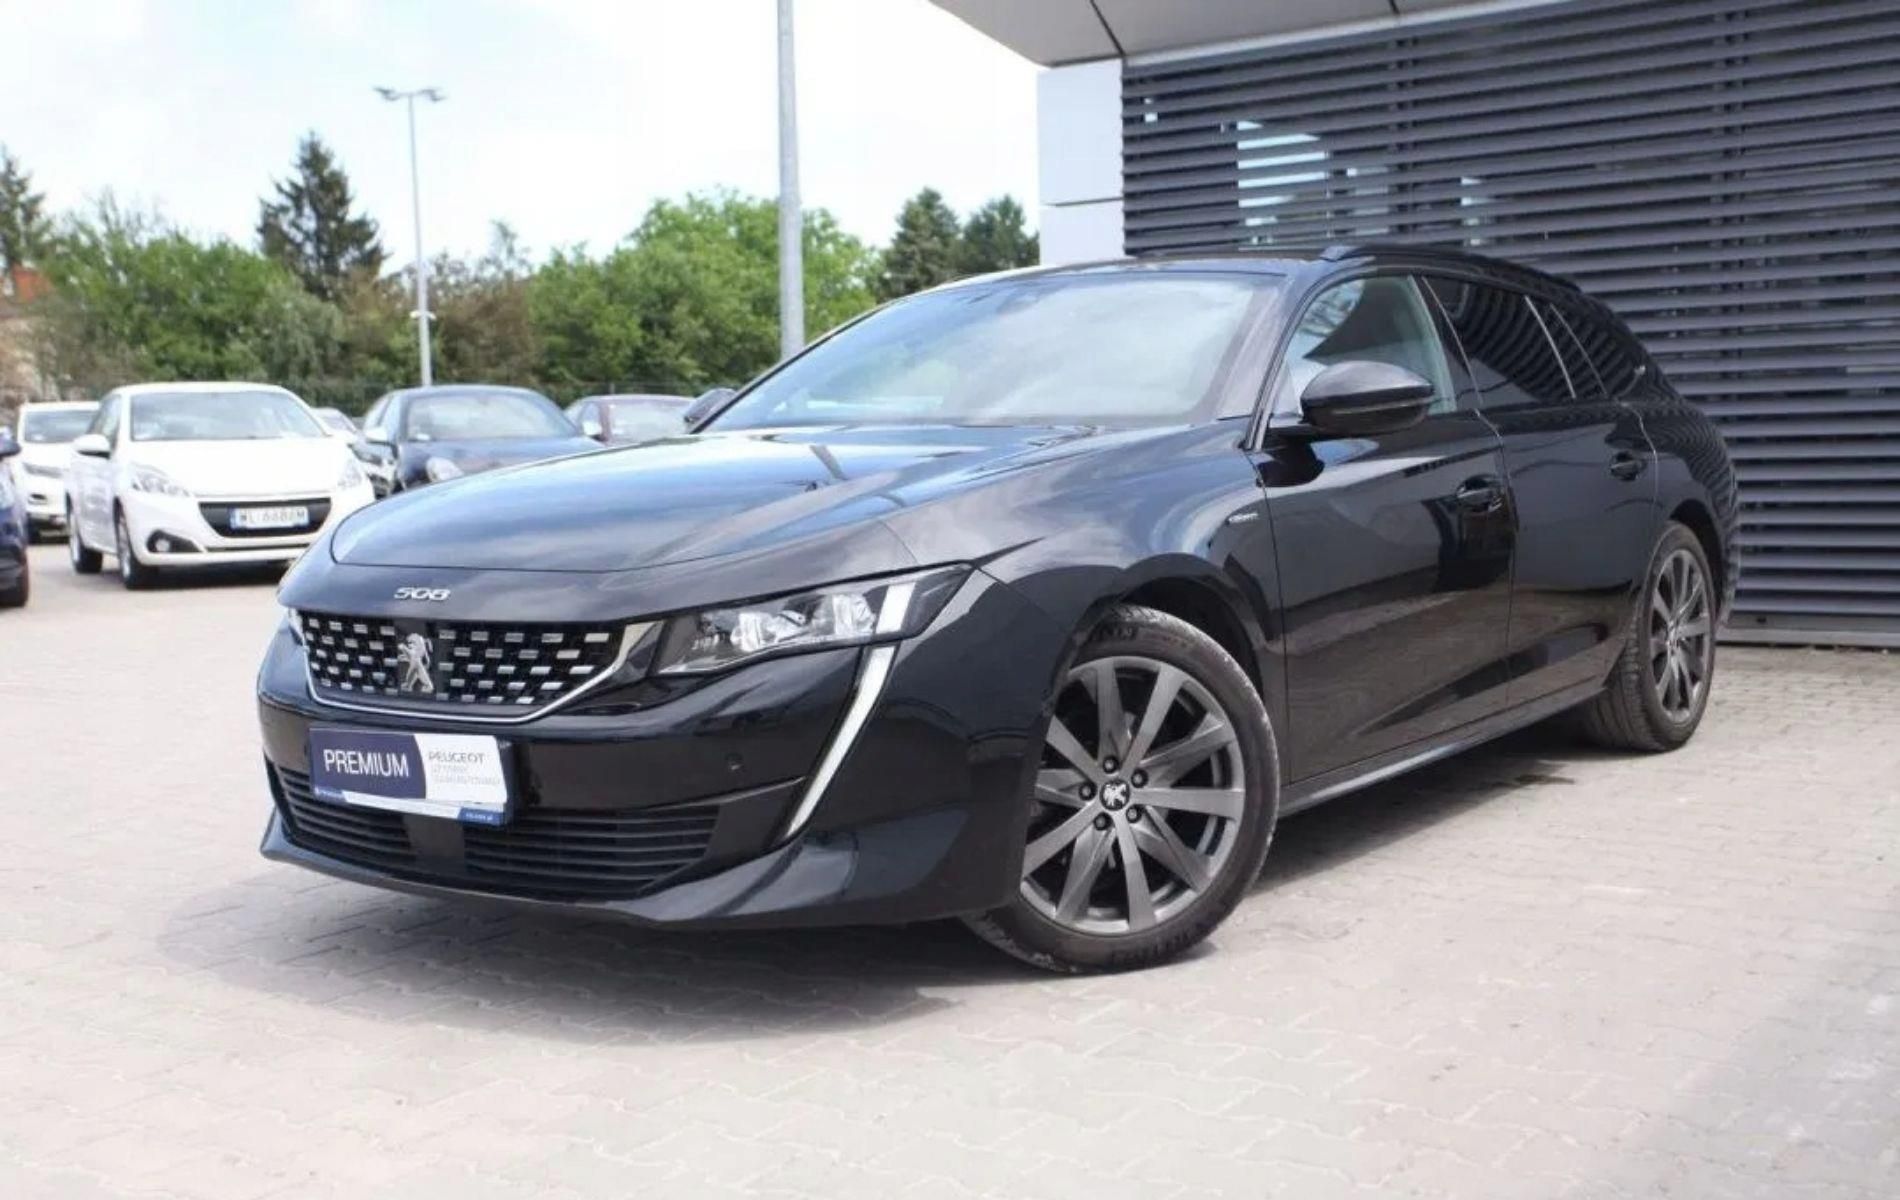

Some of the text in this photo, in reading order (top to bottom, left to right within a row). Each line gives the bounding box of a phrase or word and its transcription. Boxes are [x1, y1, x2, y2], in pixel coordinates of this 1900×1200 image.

[393, 586, 451, 601] 508
[322, 748, 410, 778] PREMIUM
[428, 750, 486, 765] PEUGEOT
